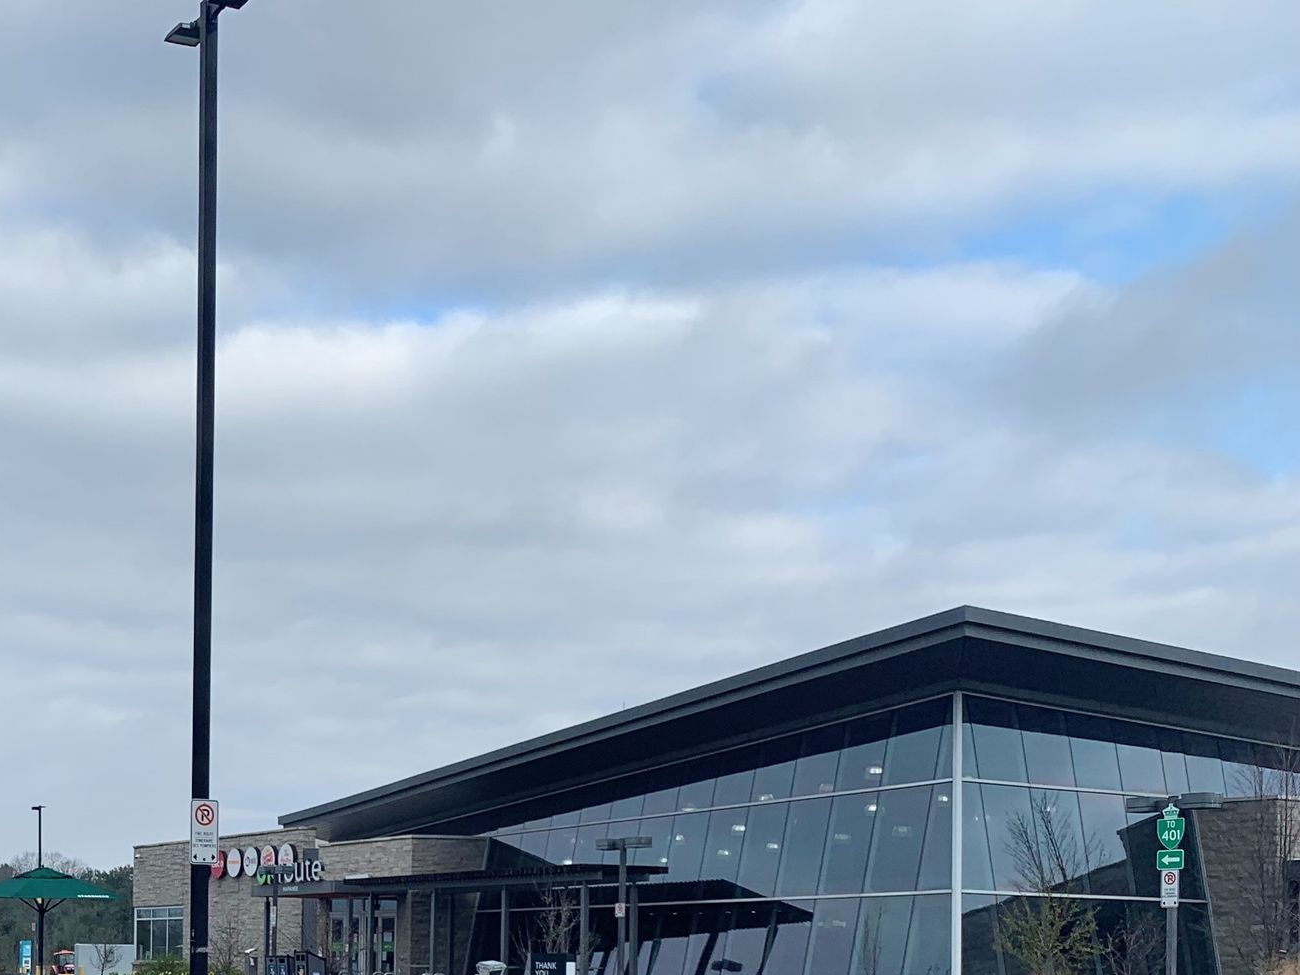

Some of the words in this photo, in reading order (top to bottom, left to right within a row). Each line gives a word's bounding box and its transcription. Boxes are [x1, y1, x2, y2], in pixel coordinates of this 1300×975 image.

[1166, 820, 1176, 828] TO
[1161, 830, 1180, 841] 401
[534, 961, 557, 970] THANK
